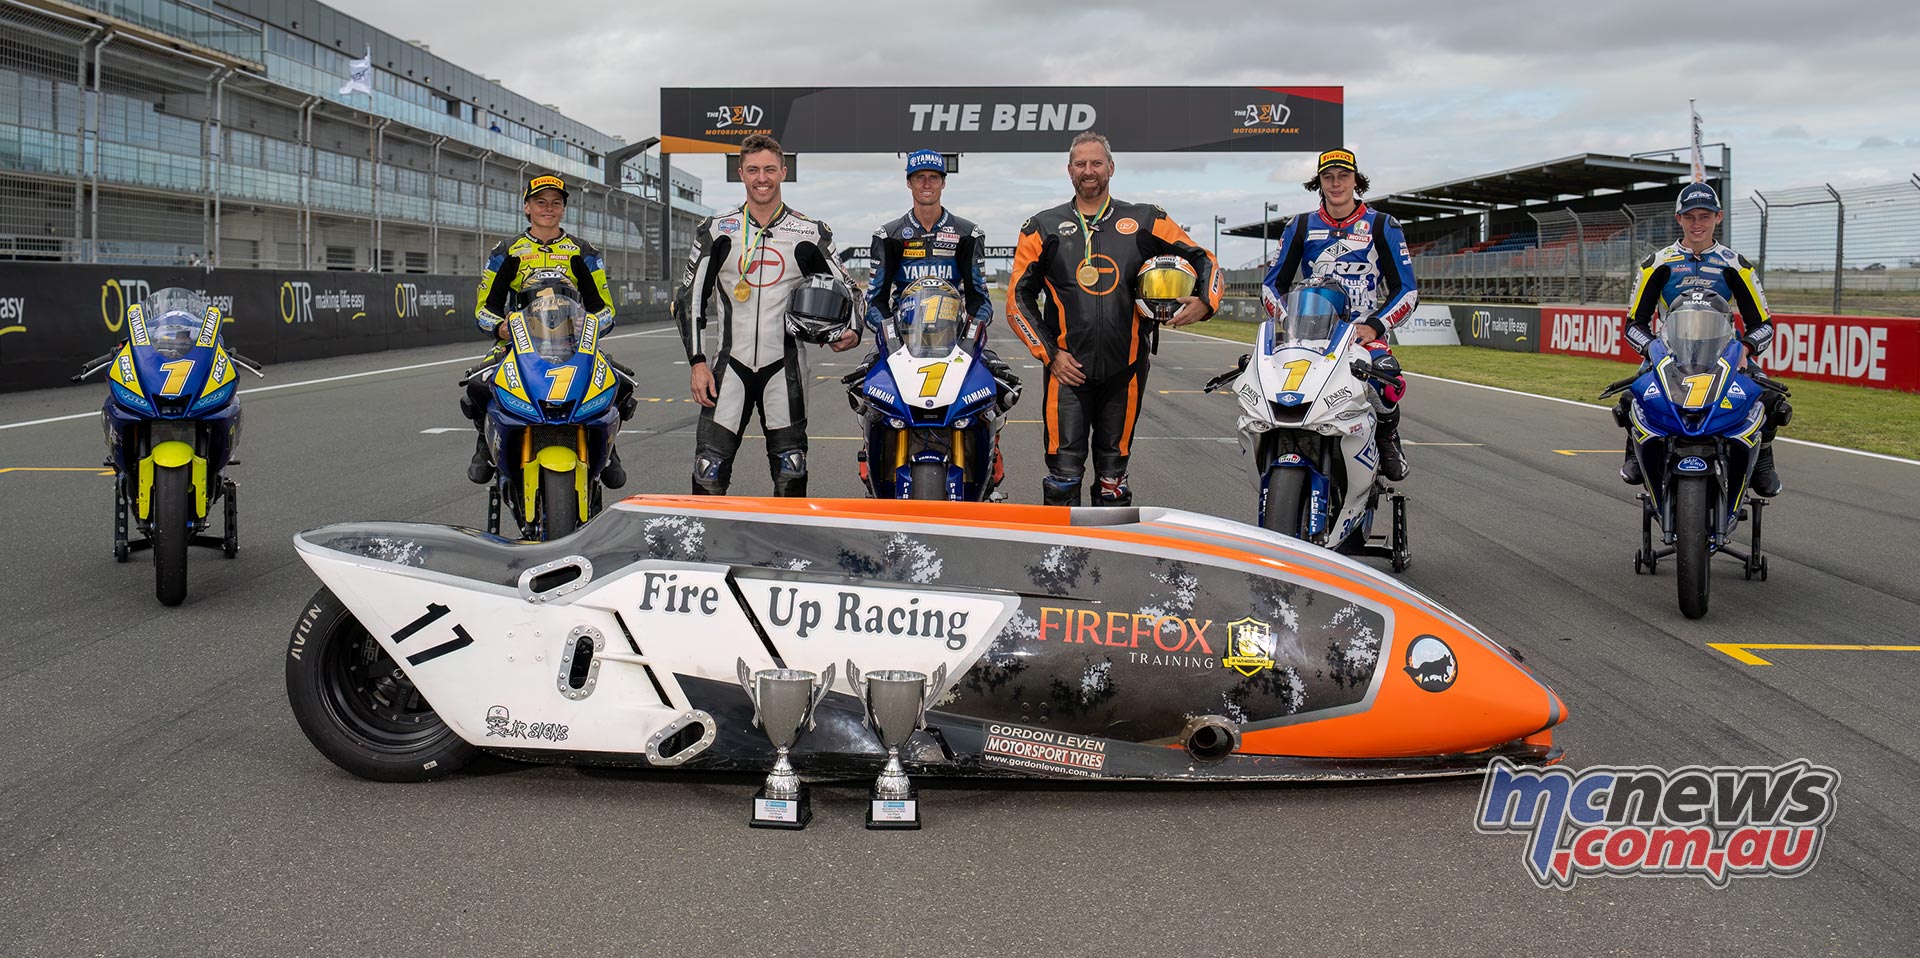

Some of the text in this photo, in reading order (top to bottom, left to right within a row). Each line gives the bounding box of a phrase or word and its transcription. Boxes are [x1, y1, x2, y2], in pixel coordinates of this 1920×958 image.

[716, 105, 763, 128] BEND
[909, 104, 1097, 131] THE BEND
[1244, 104, 1290, 127] BEND
[917, 154, 943, 165] YAMAHA
[984, 248, 1015, 257] ELAIDE
[903, 265, 952, 280] YAMAHA
[0, 297, 24, 324] asy
[280, 281, 365, 324] OTR making life easy
[395, 283, 455, 318] OTR making life easy
[920, 294, 942, 323] 1
[131, 314, 147, 344] YAMAHA
[203, 311, 219, 341] YAMAHA
[513, 323, 530, 351] YAMAHA
[583, 318, 596, 346] YAMAHA
[1472, 310, 1527, 339] OTR making life easy
[1551, 313, 1621, 355] ADELAIDE
[1627, 327, 1650, 345] YAMAHA
[159, 358, 196, 396] 1
[545, 365, 577, 402] 1
[917, 362, 949, 397] 1
[1281, 358, 1312, 391] 1
[867, 386, 895, 405] YAMAHA
[962, 387, 992, 405] YAMAHA
[1239, 383, 1261, 406] JONKERS
[1323, 386, 1353, 409] JONKERS
[1681, 373, 1716, 409] 1
[1312, 490, 1320, 533] PIRELLI
[638, 571, 970, 651] Fire Up Racing
[291, 603, 323, 661] AVON
[390, 602, 475, 667] 17
[1038, 606, 1214, 655] FIREFOX
[1129, 652, 1215, 669] TRAINING
[527, 721, 570, 742] SIGNS
[989, 724, 1106, 751] GORDON LEVEN
[985, 754, 1102, 779] www.gordonleven.com.au
[988, 737, 1102, 768] MOTORSPORT TYRES
